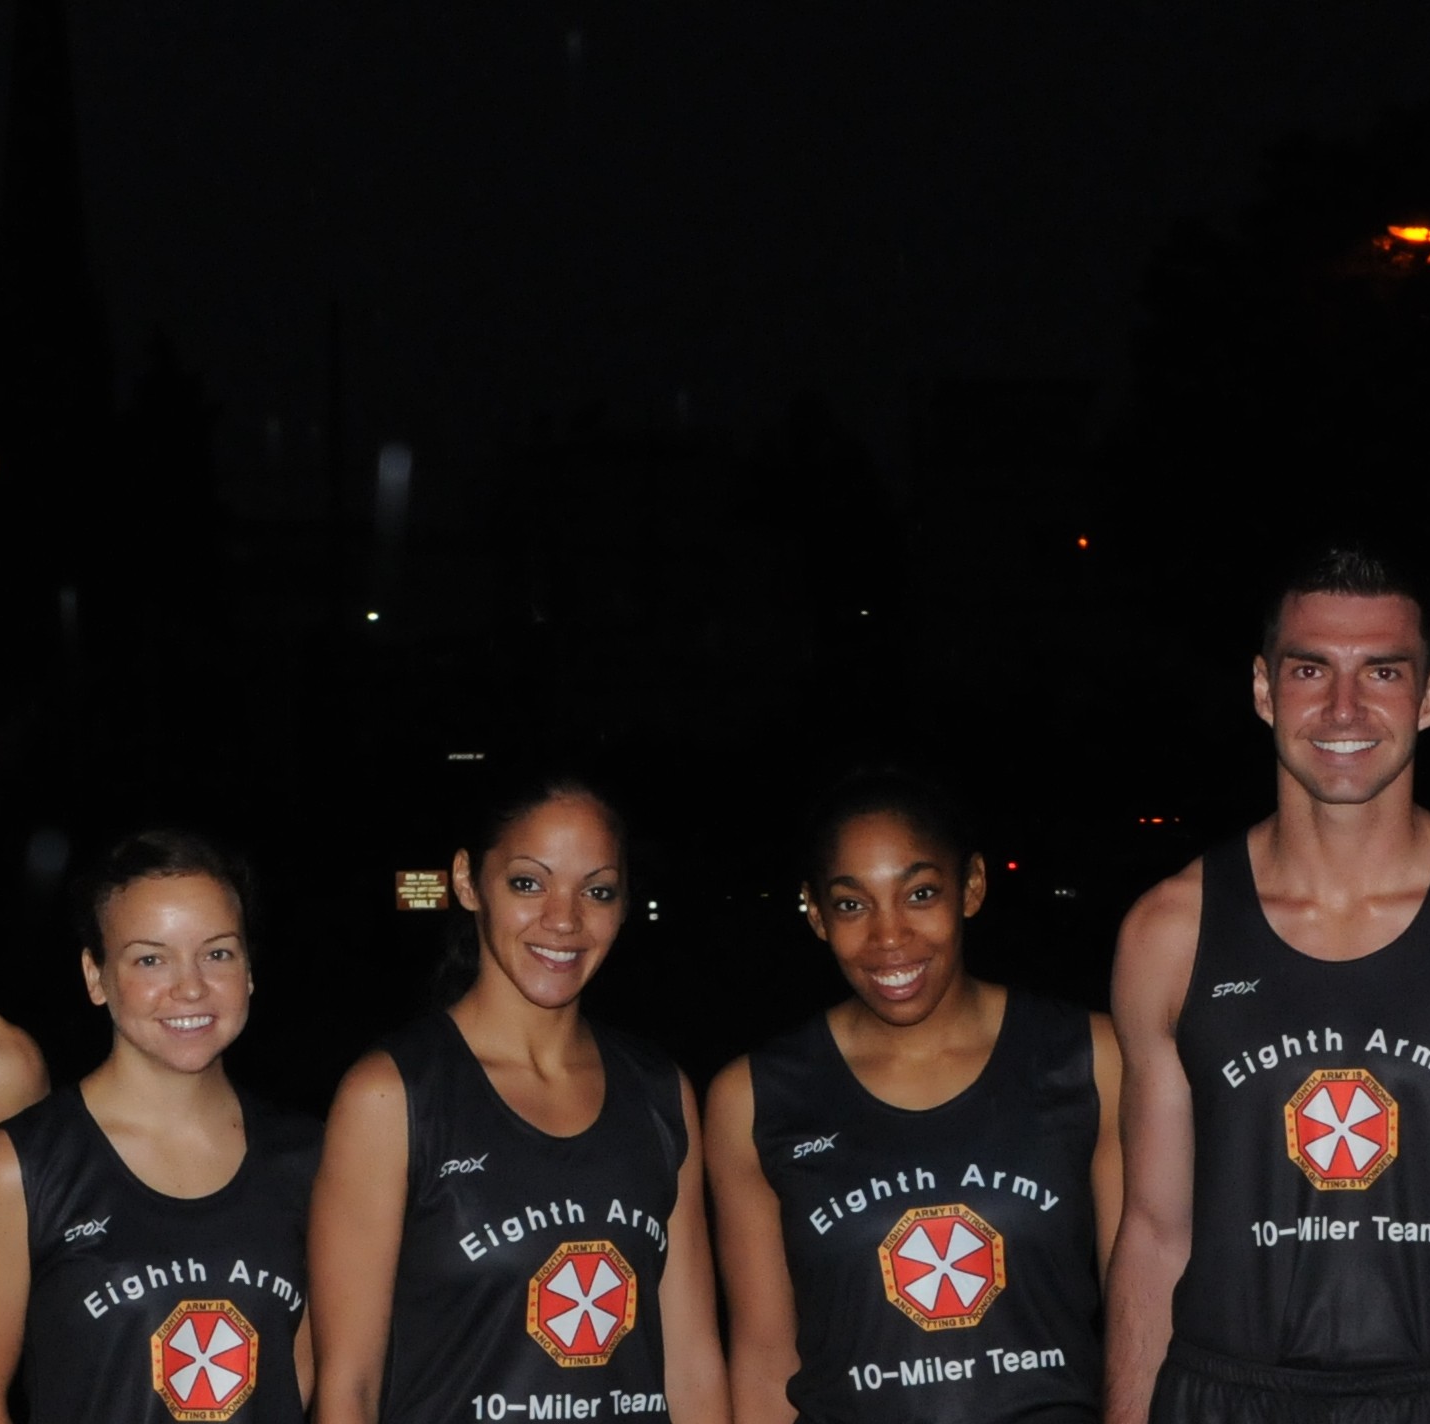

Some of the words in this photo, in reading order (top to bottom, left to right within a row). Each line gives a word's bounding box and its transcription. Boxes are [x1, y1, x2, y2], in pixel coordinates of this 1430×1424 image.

[1212, 979, 1261, 998] SPOX
[1222, 1027, 1343, 1088] Eighth
[1289, 1076, 1319, 1108] EIGHTH
[1363, 1075, 1393, 1108] STRONG
[792, 1132, 839, 1159] SPOX
[439, 1153, 489, 1178] SPOX
[809, 1168, 935, 1235] Eighth
[961, 1164, 1059, 1211] Army
[459, 1199, 585, 1262] Eighth
[607, 1199, 667, 1252] Army
[883, 1216, 911, 1249] EIGHTH
[914, 1208, 945, 1218] ARMY
[962, 1211, 997, 1239] STRONG
[535, 1249, 564, 1281] EIGHTH
[566, 1244, 594, 1252] ARMY
[608, 1248, 633, 1278] STRONG
[84, 1258, 207, 1319] Eighth
[229, 1260, 302, 1312] Army
[157, 1308, 184, 1338] EIGHTH
[226, 1307, 254, 1338] STRONG
[848, 1356, 976, 1391] 10-Miler
[986, 1347, 1065, 1374] Team
[472, 1393, 601, 1420] 10-Miler
[609, 1390, 667, 1415] Team
